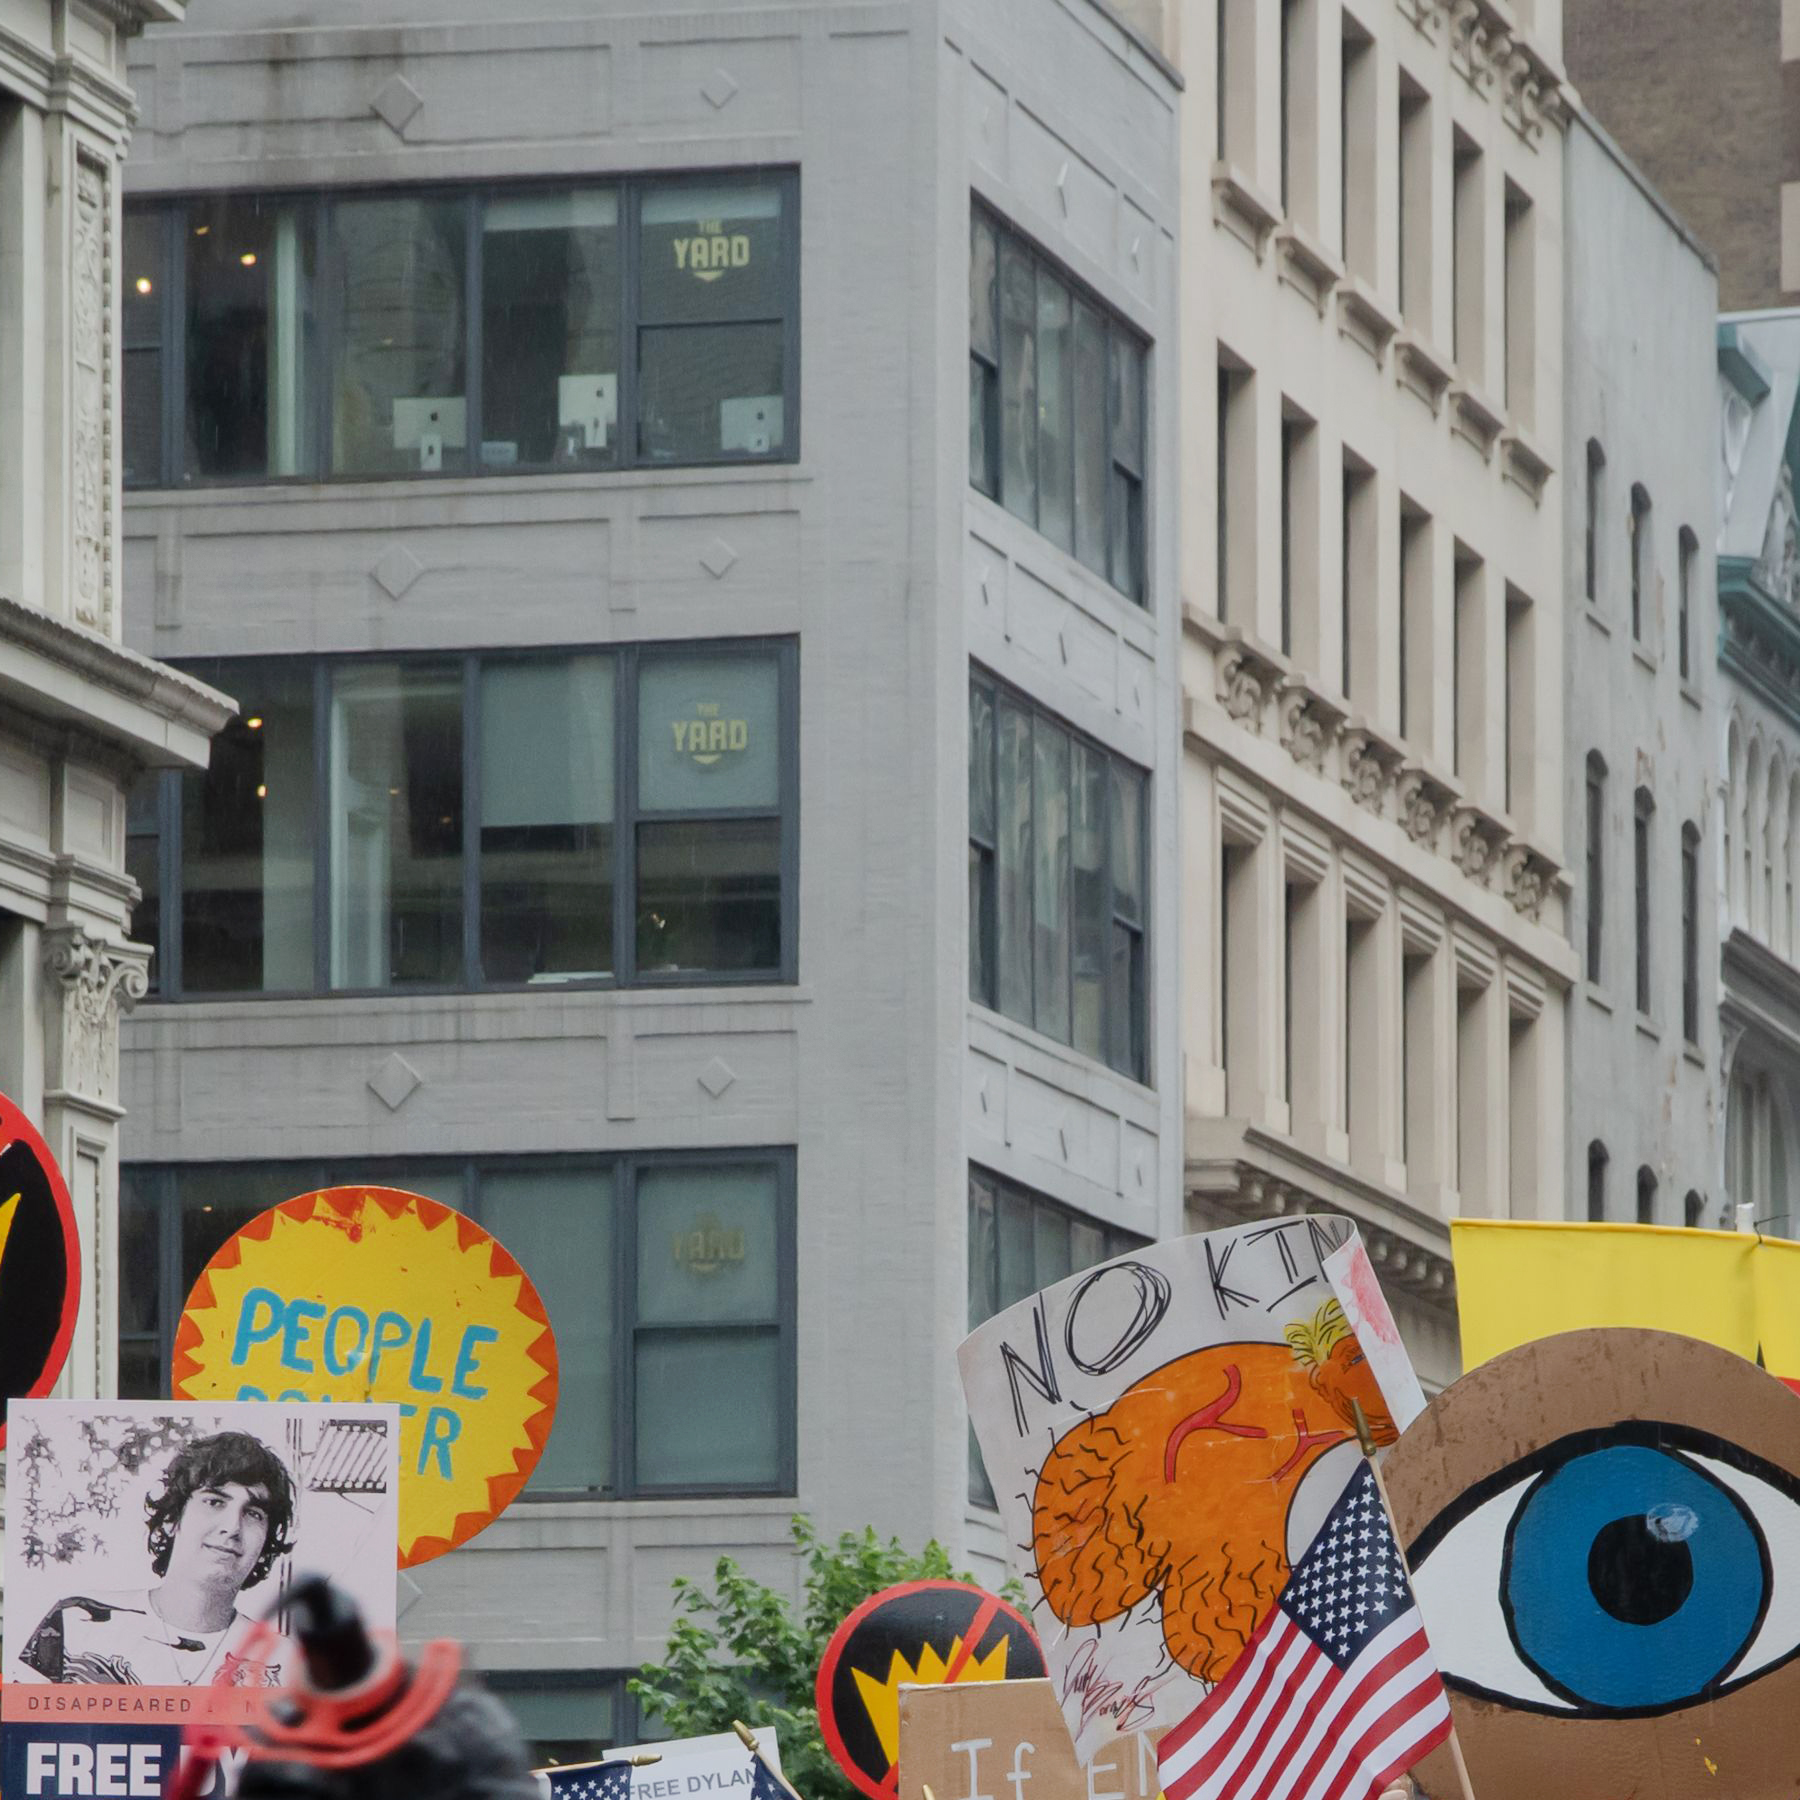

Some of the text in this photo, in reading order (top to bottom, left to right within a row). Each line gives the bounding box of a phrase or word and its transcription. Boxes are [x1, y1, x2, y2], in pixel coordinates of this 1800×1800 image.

[673, 235, 750, 269] YARD
[671, 719, 748, 751] YARD
[231, 1286, 499, 1400] PEOPLE
[1001, 1261, 1172, 1437] NO
[28, 1696, 192, 1713] DISAPPEARED
[27, 1742, 162, 1797] FREE
